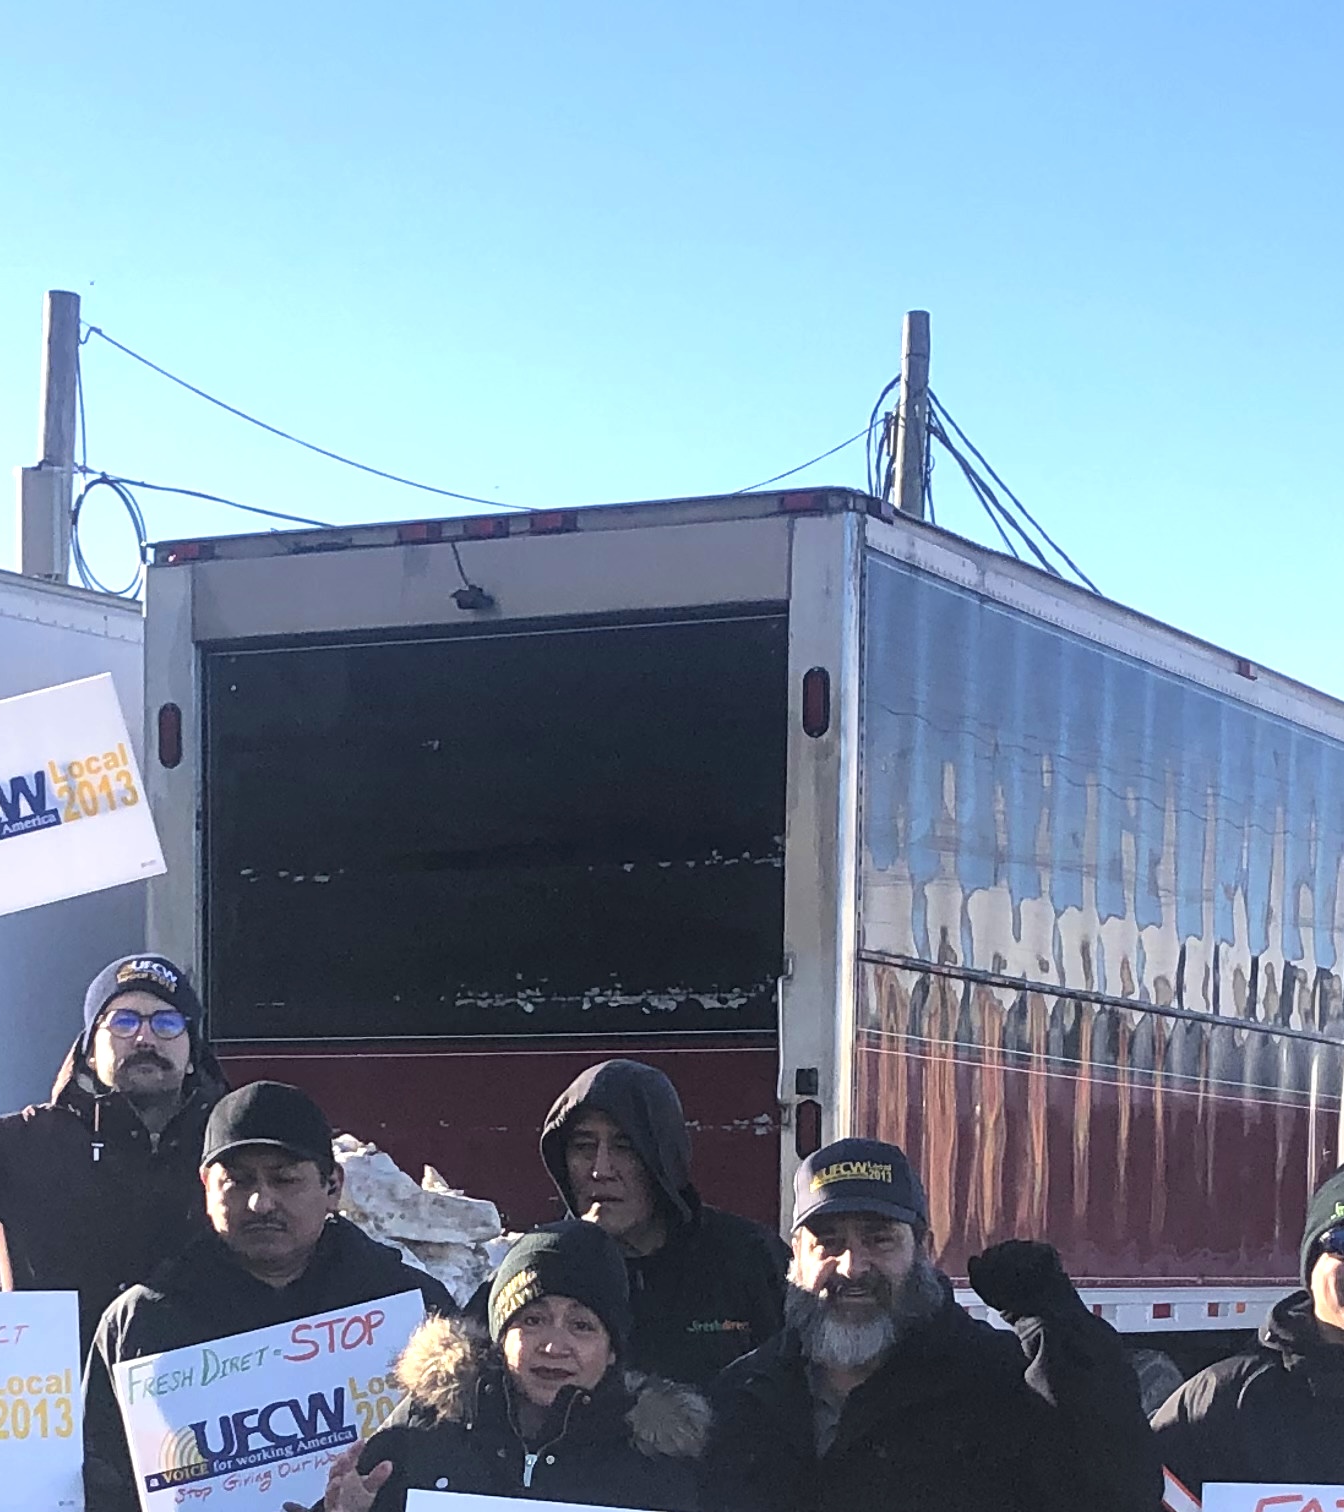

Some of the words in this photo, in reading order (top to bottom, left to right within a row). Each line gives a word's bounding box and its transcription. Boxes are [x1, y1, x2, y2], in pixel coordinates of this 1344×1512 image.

[48, 743, 129, 784] Local
[56, 768, 139, 823] 2013
[2, 813, 56, 835] America
[131, 960, 178, 983] UFCW
[823, 1161, 869, 1179] UFCW
[128, 1360, 193, 1405] FRESH
[283, 1310, 384, 1361] STOP
[189, 1386, 345, 1460] UFCW
[149, 1478, 159, 1487] a
[163, 1462, 209, 1483] VOICE
[213, 1459, 233, 1472] for
[235, 1444, 293, 1465] working
[297, 1429, 354, 1454] America
